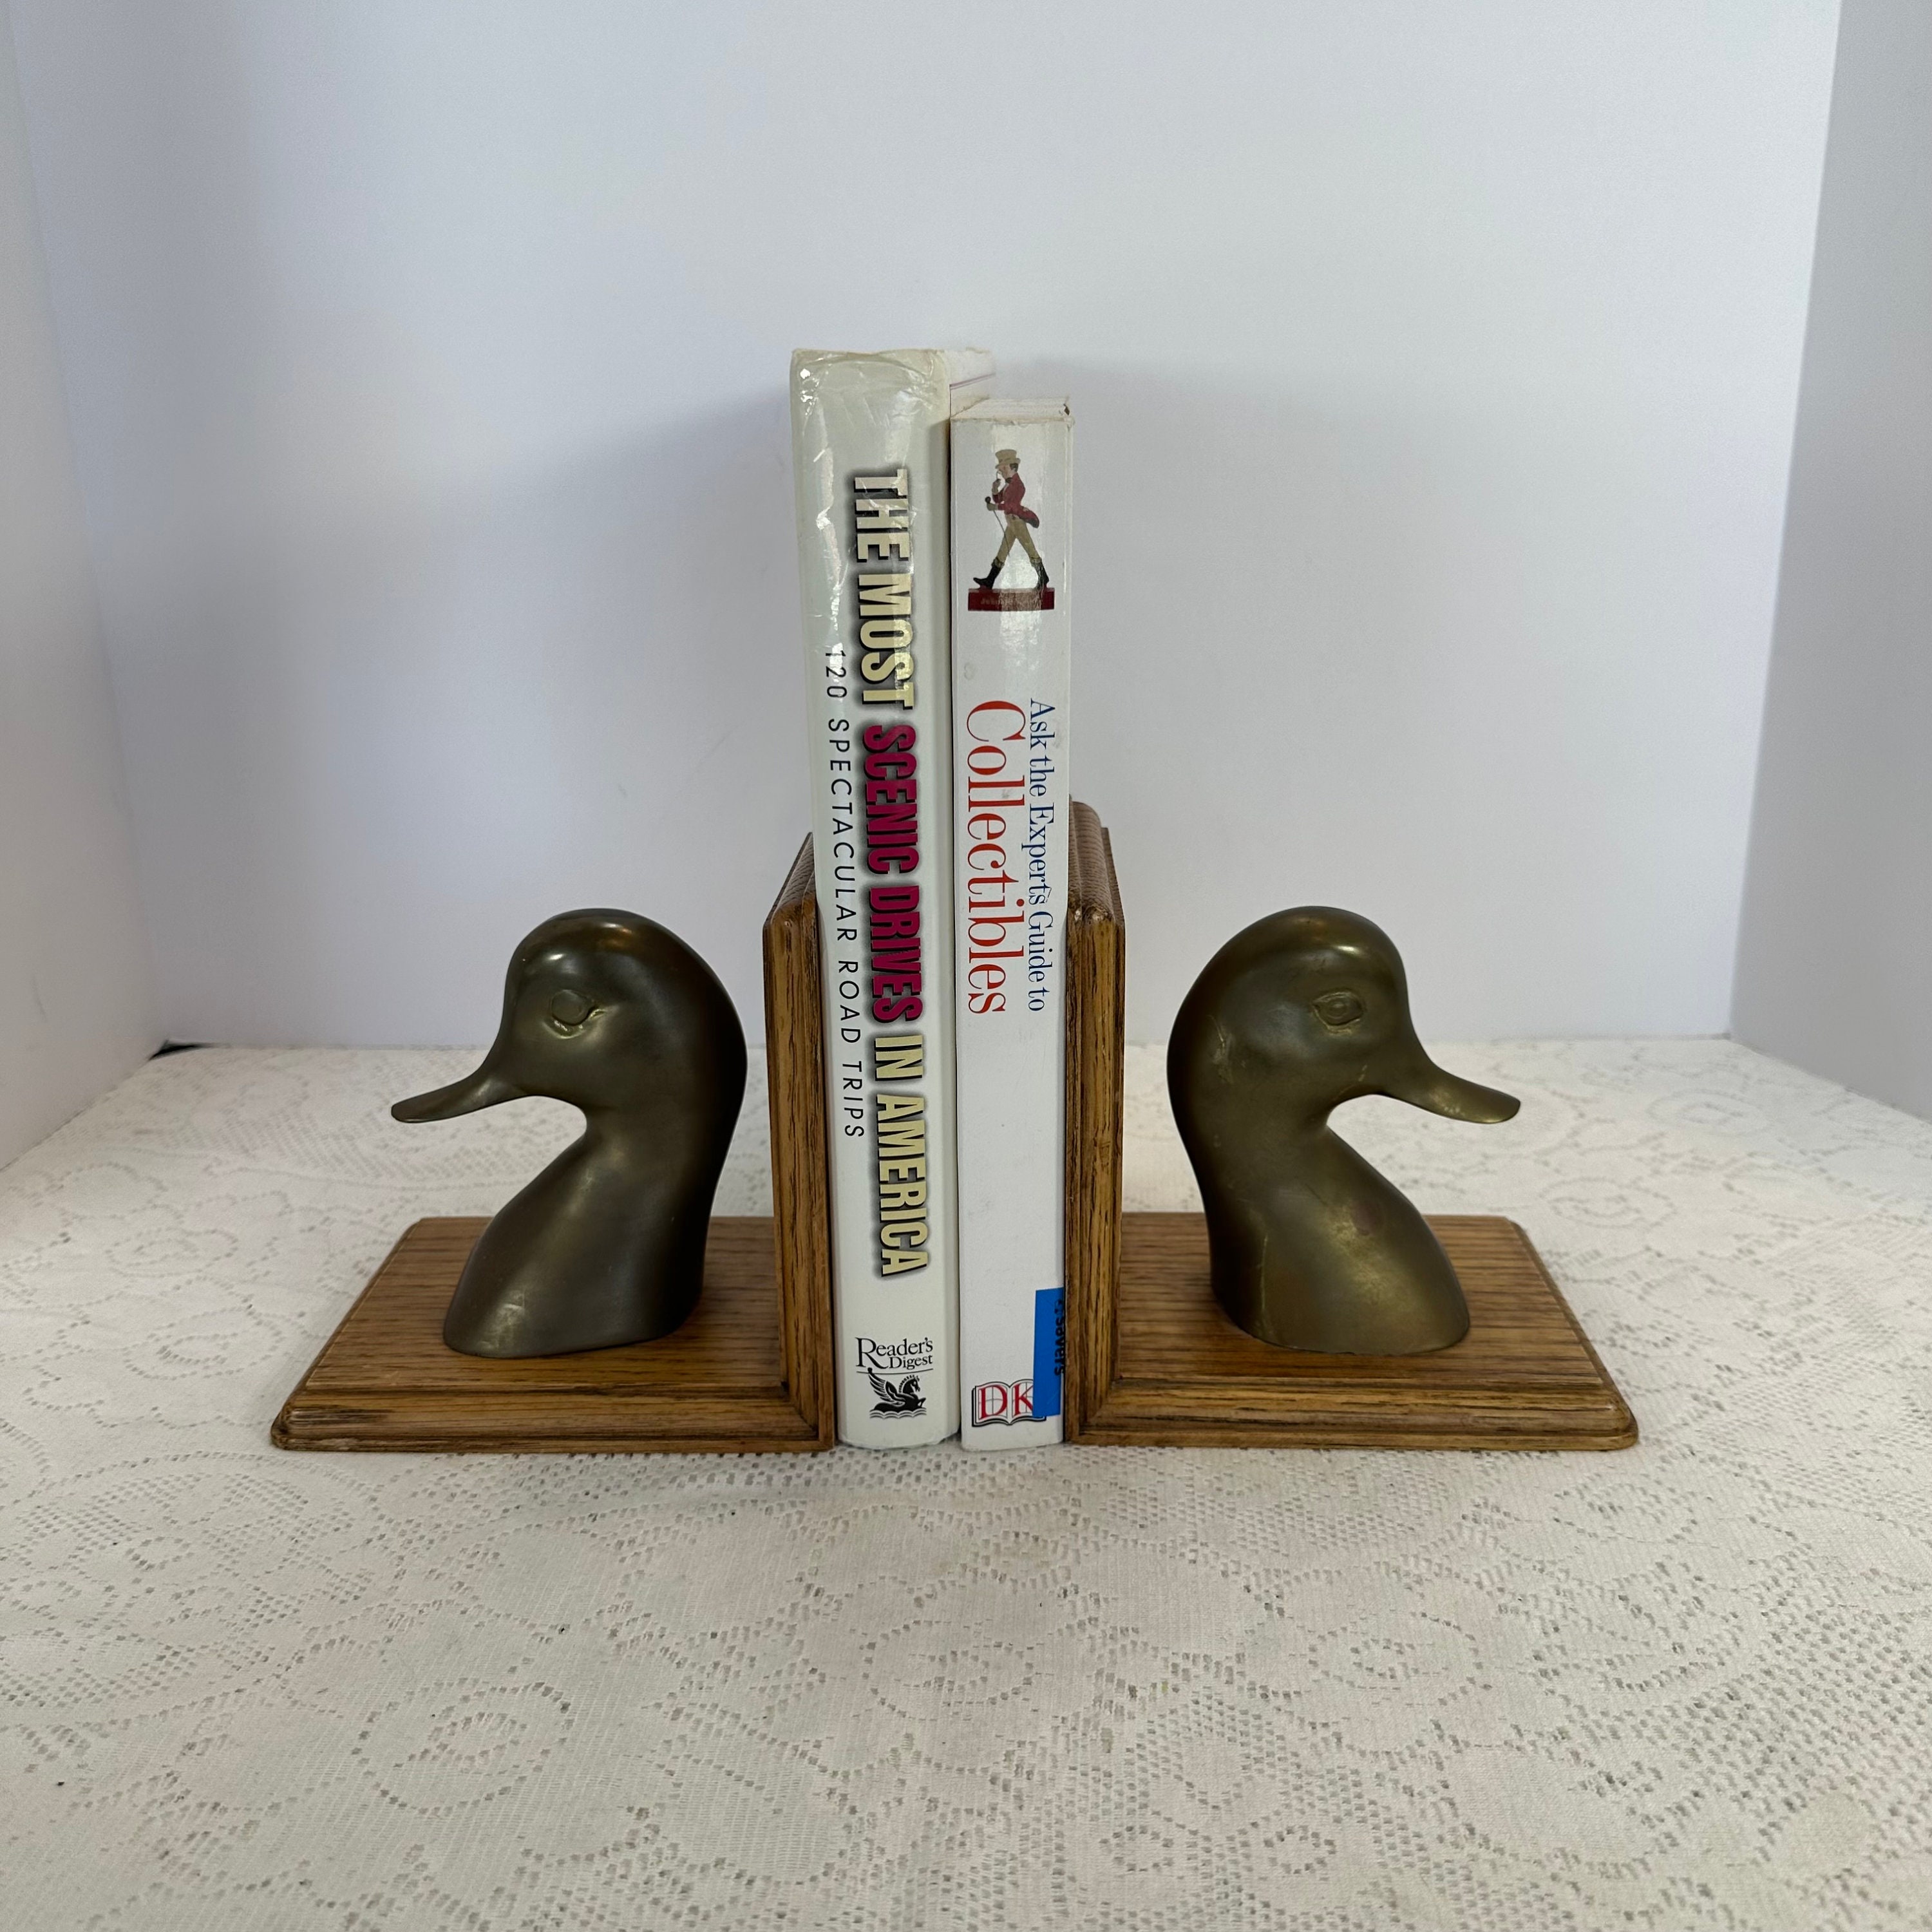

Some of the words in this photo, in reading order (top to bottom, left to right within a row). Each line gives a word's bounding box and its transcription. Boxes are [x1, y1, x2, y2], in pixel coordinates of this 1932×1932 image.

[854, 469, 909, 562] THE
[825, 650, 847, 697] 120
[858, 574, 914, 709] MOST
[1029, 699, 1056, 750] Ask
[863, 725, 917, 874] SCENIC
[1028, 753, 1055, 797] the
[828, 719, 857, 942] SPECTACULAR
[967, 701, 1026, 1013] Collectibles
[1021, 802, 1054, 905] Experts
[869, 885, 922, 1023] DRIVES
[1028, 912, 1054, 981] Guide
[838, 960, 861, 1045] ROAD
[1028, 987, 1045, 1012] to
[874, 1035, 923, 1080] IN
[842, 1061, 864, 1138] TRIPS
[876, 1094, 928, 1277] AMERICA
[855, 1337, 933, 1369] Reader's
[889, 1355, 933, 1370] Digest
[978, 1383, 1033, 1419] DK
